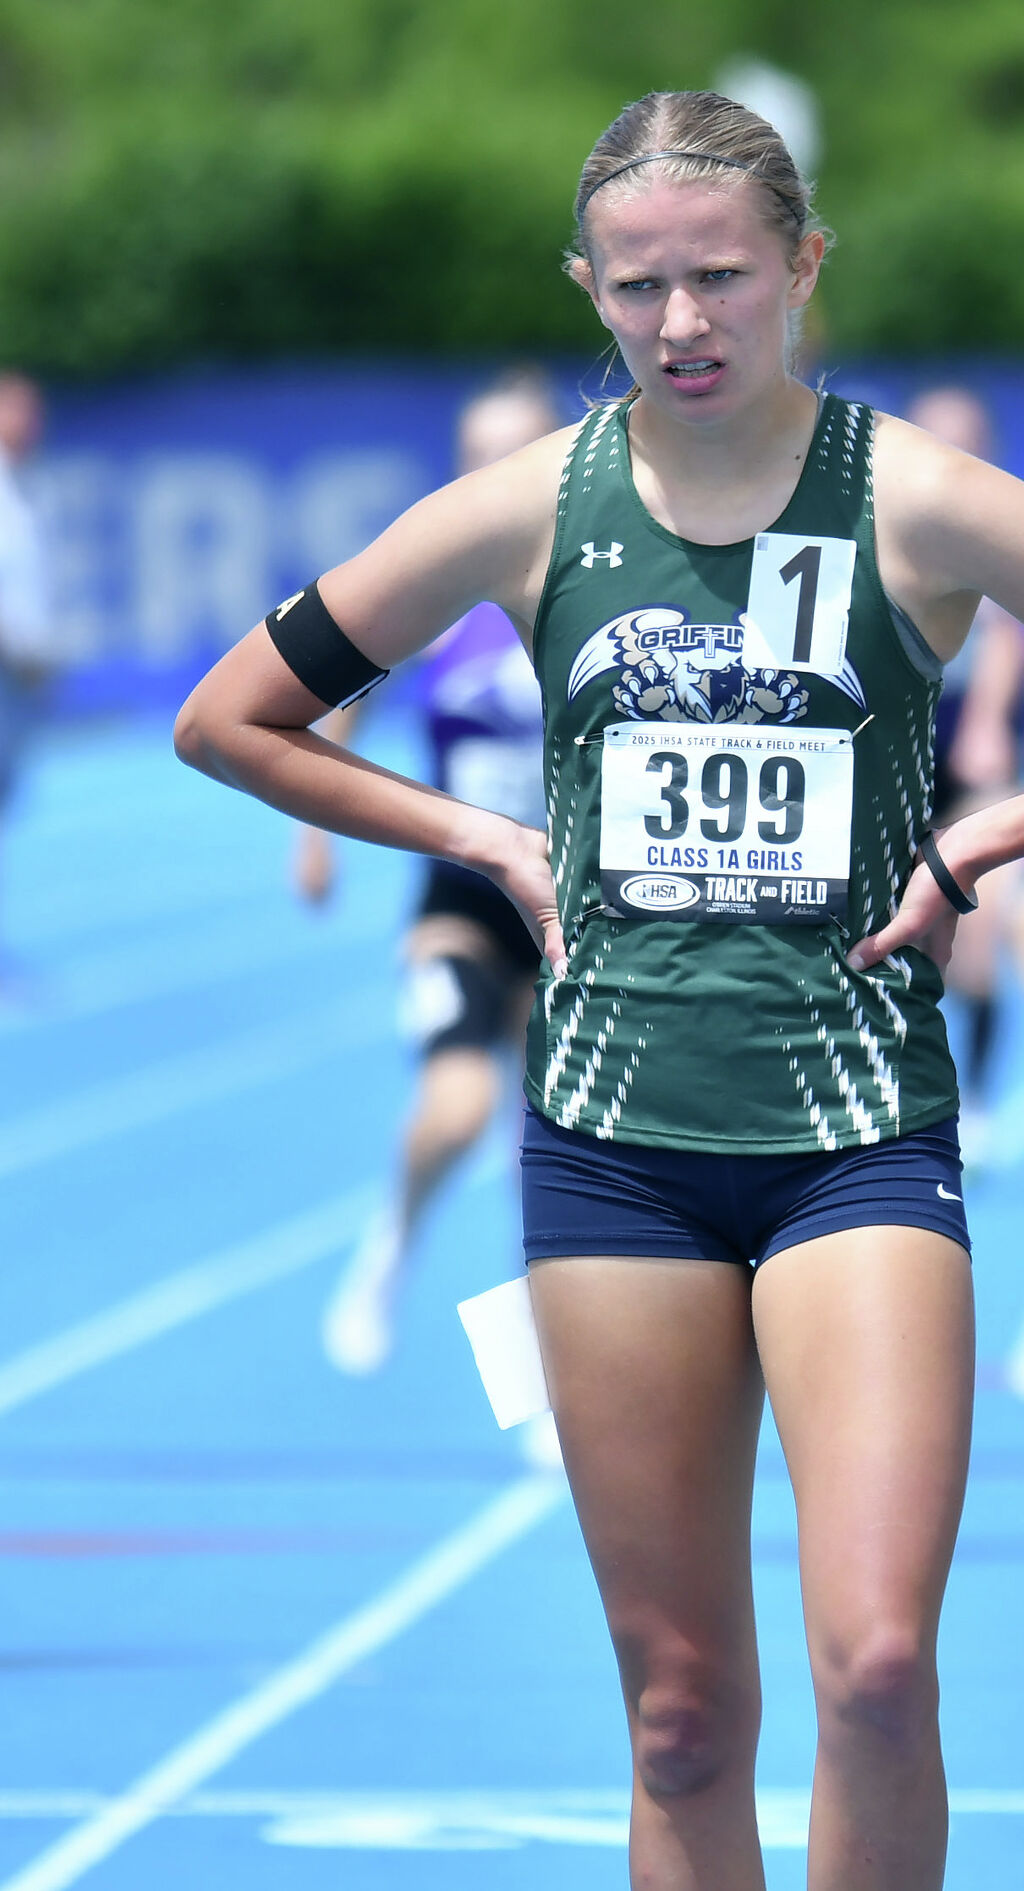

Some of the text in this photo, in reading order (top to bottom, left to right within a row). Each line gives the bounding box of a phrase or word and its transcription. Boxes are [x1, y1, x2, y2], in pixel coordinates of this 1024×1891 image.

[779, 546, 822, 663] 1
[632, 735, 826, 752] 2025 IHSA STATE TRACK & FIELD MEET
[644, 751, 805, 845] 399
[647, 845, 803, 871] CLASS 1A GIRLS
[705, 877, 828, 905] TRACK AND FIELD
